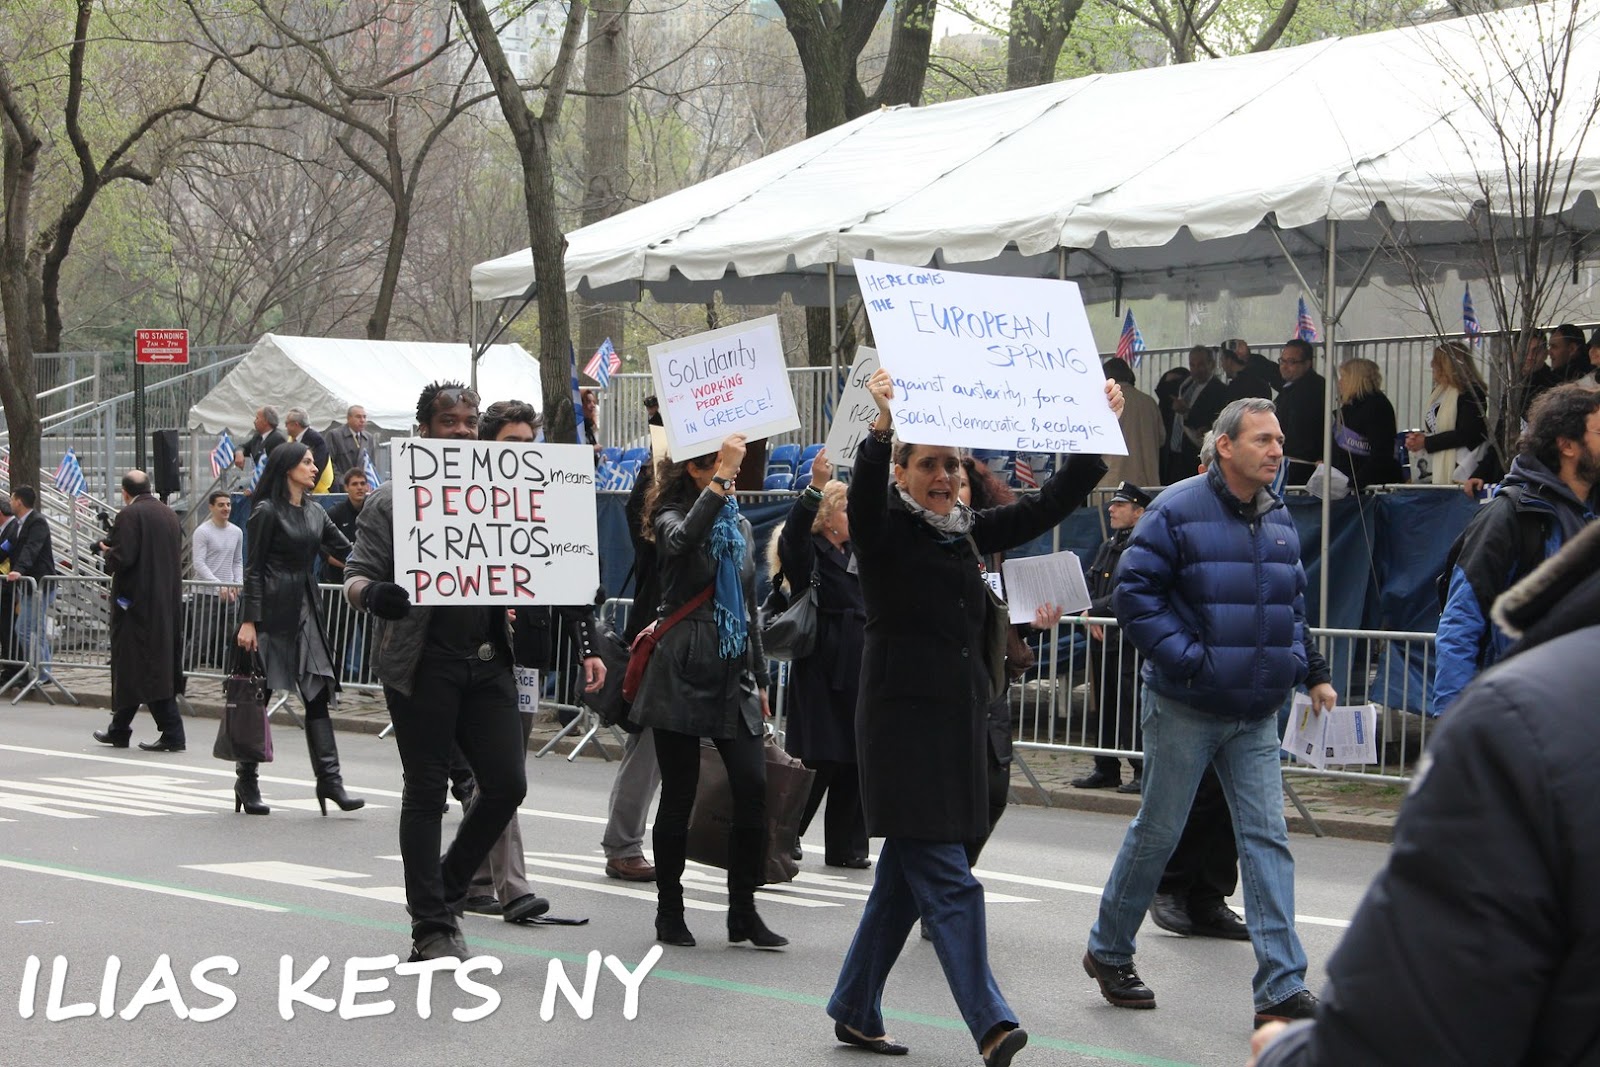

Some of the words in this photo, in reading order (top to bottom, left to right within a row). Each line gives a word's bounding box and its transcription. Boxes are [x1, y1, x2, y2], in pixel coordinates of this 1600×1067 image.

[865, 273, 905, 292] HERE
[907, 272, 945, 286] COMES
[868, 298, 895, 313] THE
[909, 299, 1050, 340] EUROPEAN
[140, 332, 150, 340] NO
[152, 332, 184, 340] STANDING
[146, 340, 159, 348] 7AM
[167, 340, 179, 348] 7PM
[986, 343, 1088, 374] SPRING
[667, 394, 685, 404] WITH
[695, 390, 735, 411] PEOPLE
[703, 387, 774, 428] GREECE!
[1033, 388, 1060, 409] for
[1062, 395, 1079, 406] a
[550, 468, 593, 485] means
[408, 485, 546, 523] PEOPLE
[551, 541, 594, 557] means
[406, 563, 536, 603] POWER
